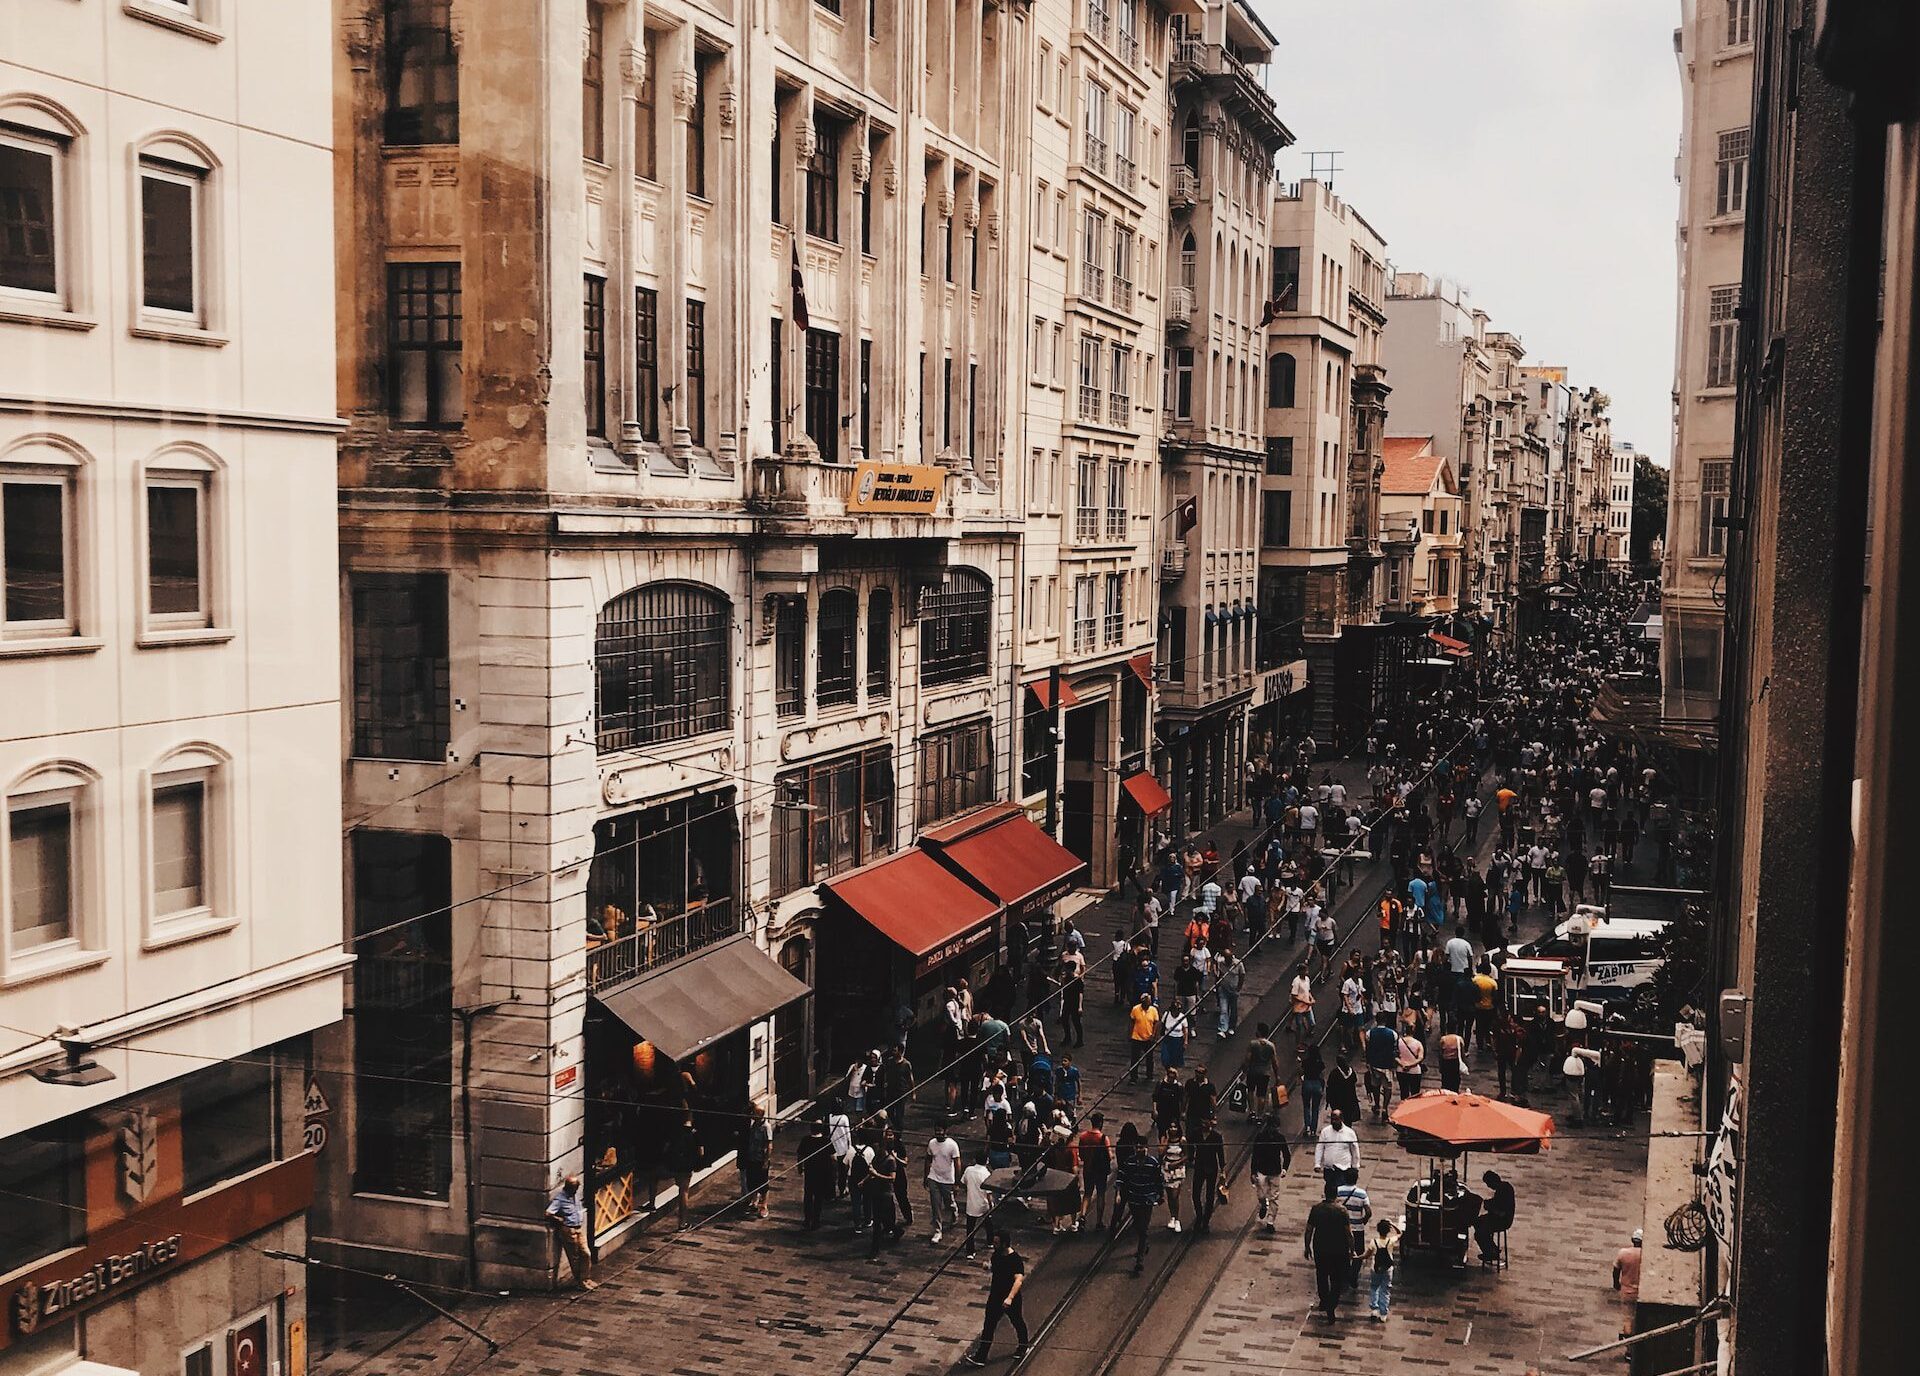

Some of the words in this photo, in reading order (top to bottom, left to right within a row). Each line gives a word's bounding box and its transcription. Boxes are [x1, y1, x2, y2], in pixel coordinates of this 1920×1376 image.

[304, 1127, 323, 1149] 20
[41, 1263, 106, 1315] Ziraat
[105, 1233, 182, 1285] Bankası
